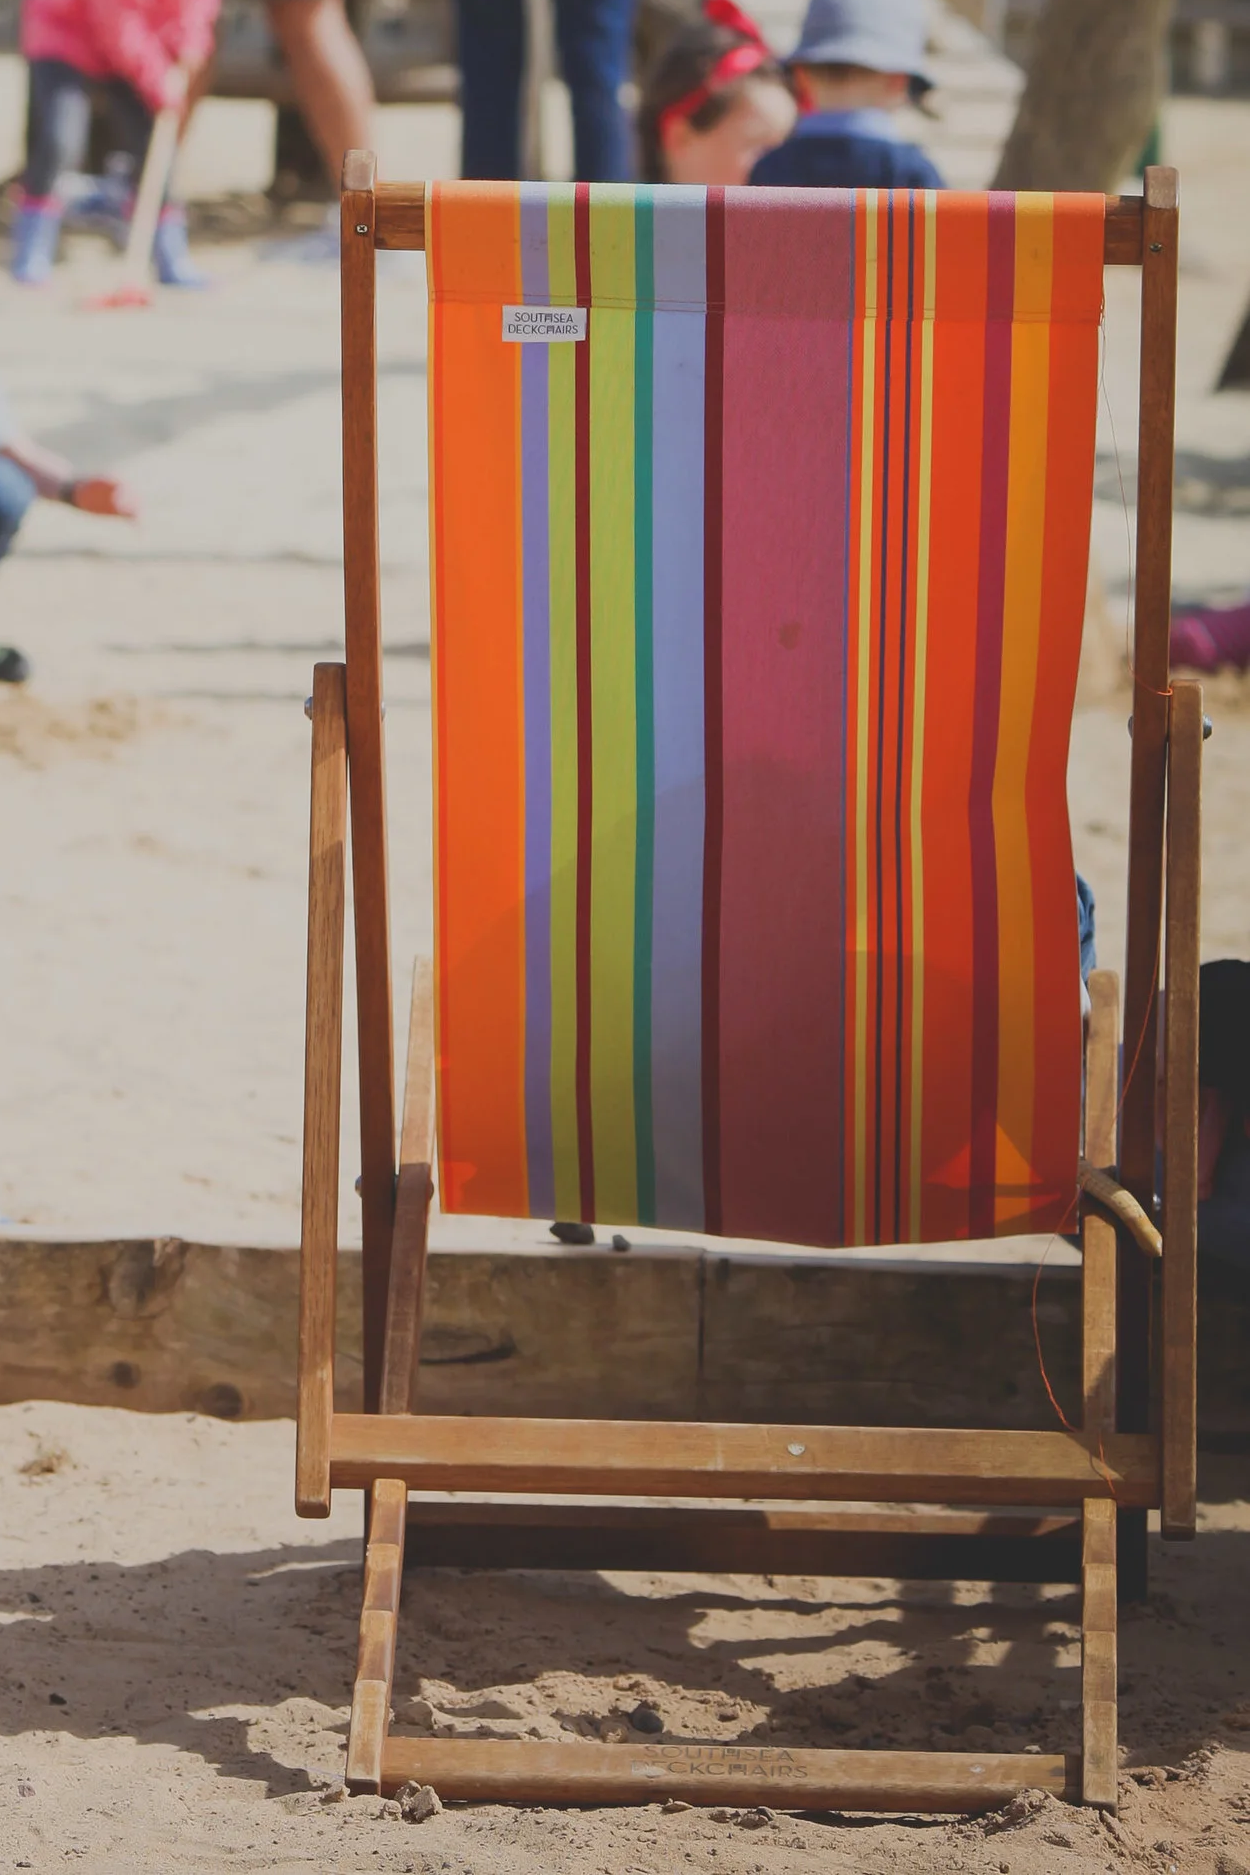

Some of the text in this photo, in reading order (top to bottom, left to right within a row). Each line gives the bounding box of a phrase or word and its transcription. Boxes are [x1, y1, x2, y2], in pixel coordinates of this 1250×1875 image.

[514, 312, 574, 323] SOUTHSEA
[508, 323, 579, 335] DECKCHAIRS
[644, 1746, 795, 1762] SOUTHSEA
